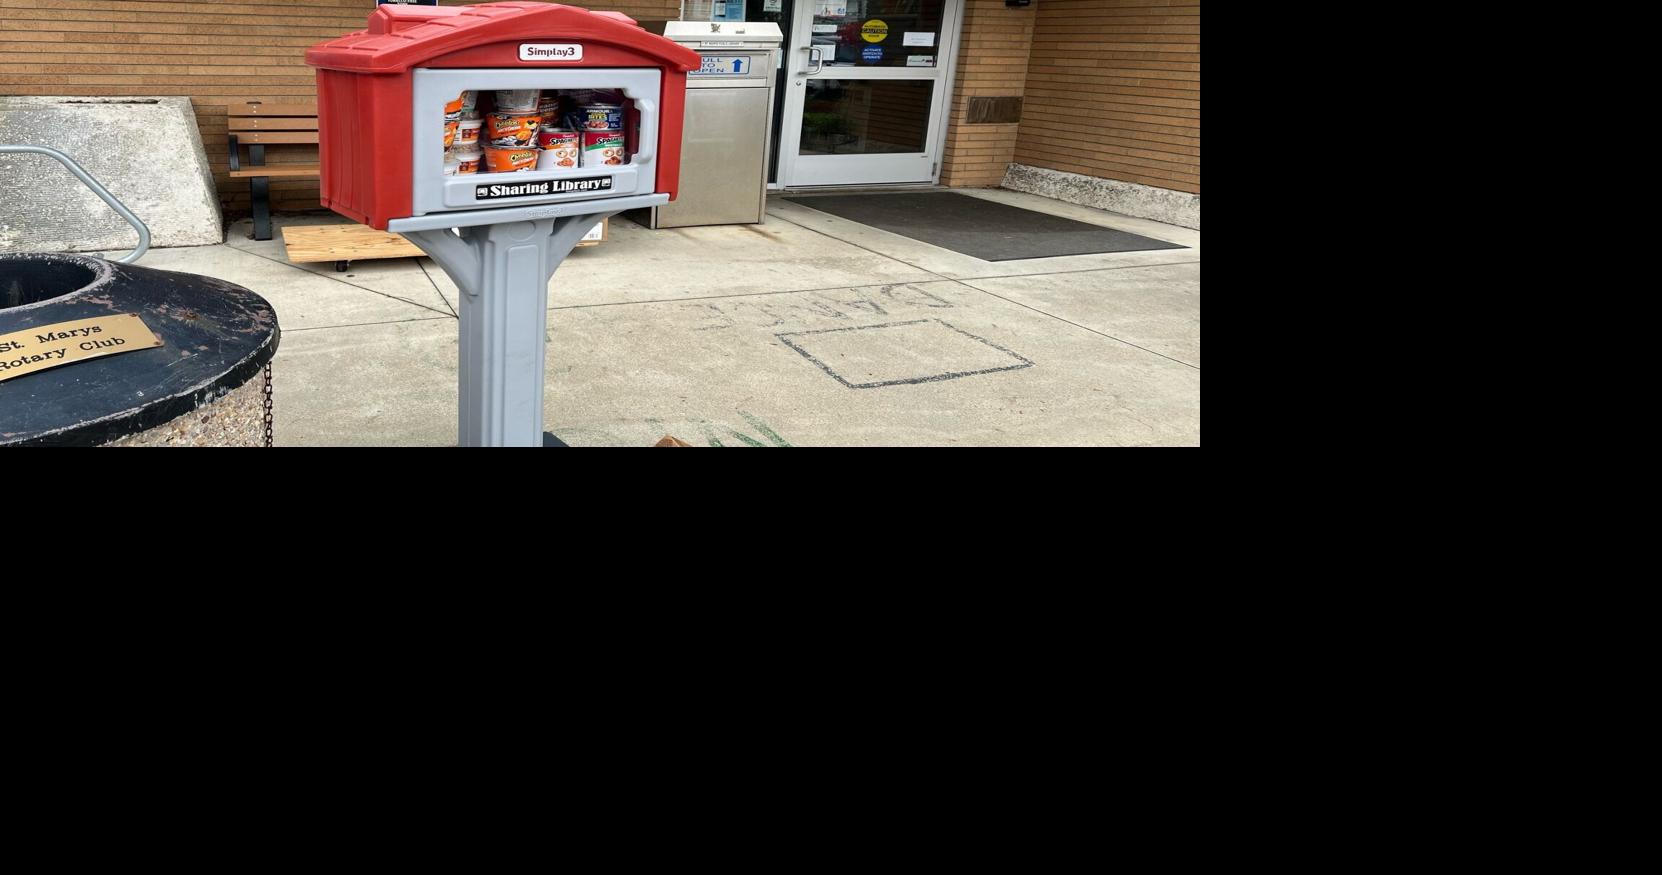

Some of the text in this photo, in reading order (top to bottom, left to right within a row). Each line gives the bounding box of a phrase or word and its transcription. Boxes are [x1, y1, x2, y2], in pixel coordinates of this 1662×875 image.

[527, 47, 575, 57] Simplay3
[490, 178, 602, 197] Sharing Library
[0, 324, 102, 353] St. Marys
[0, 336, 126, 372] Rotary Club
